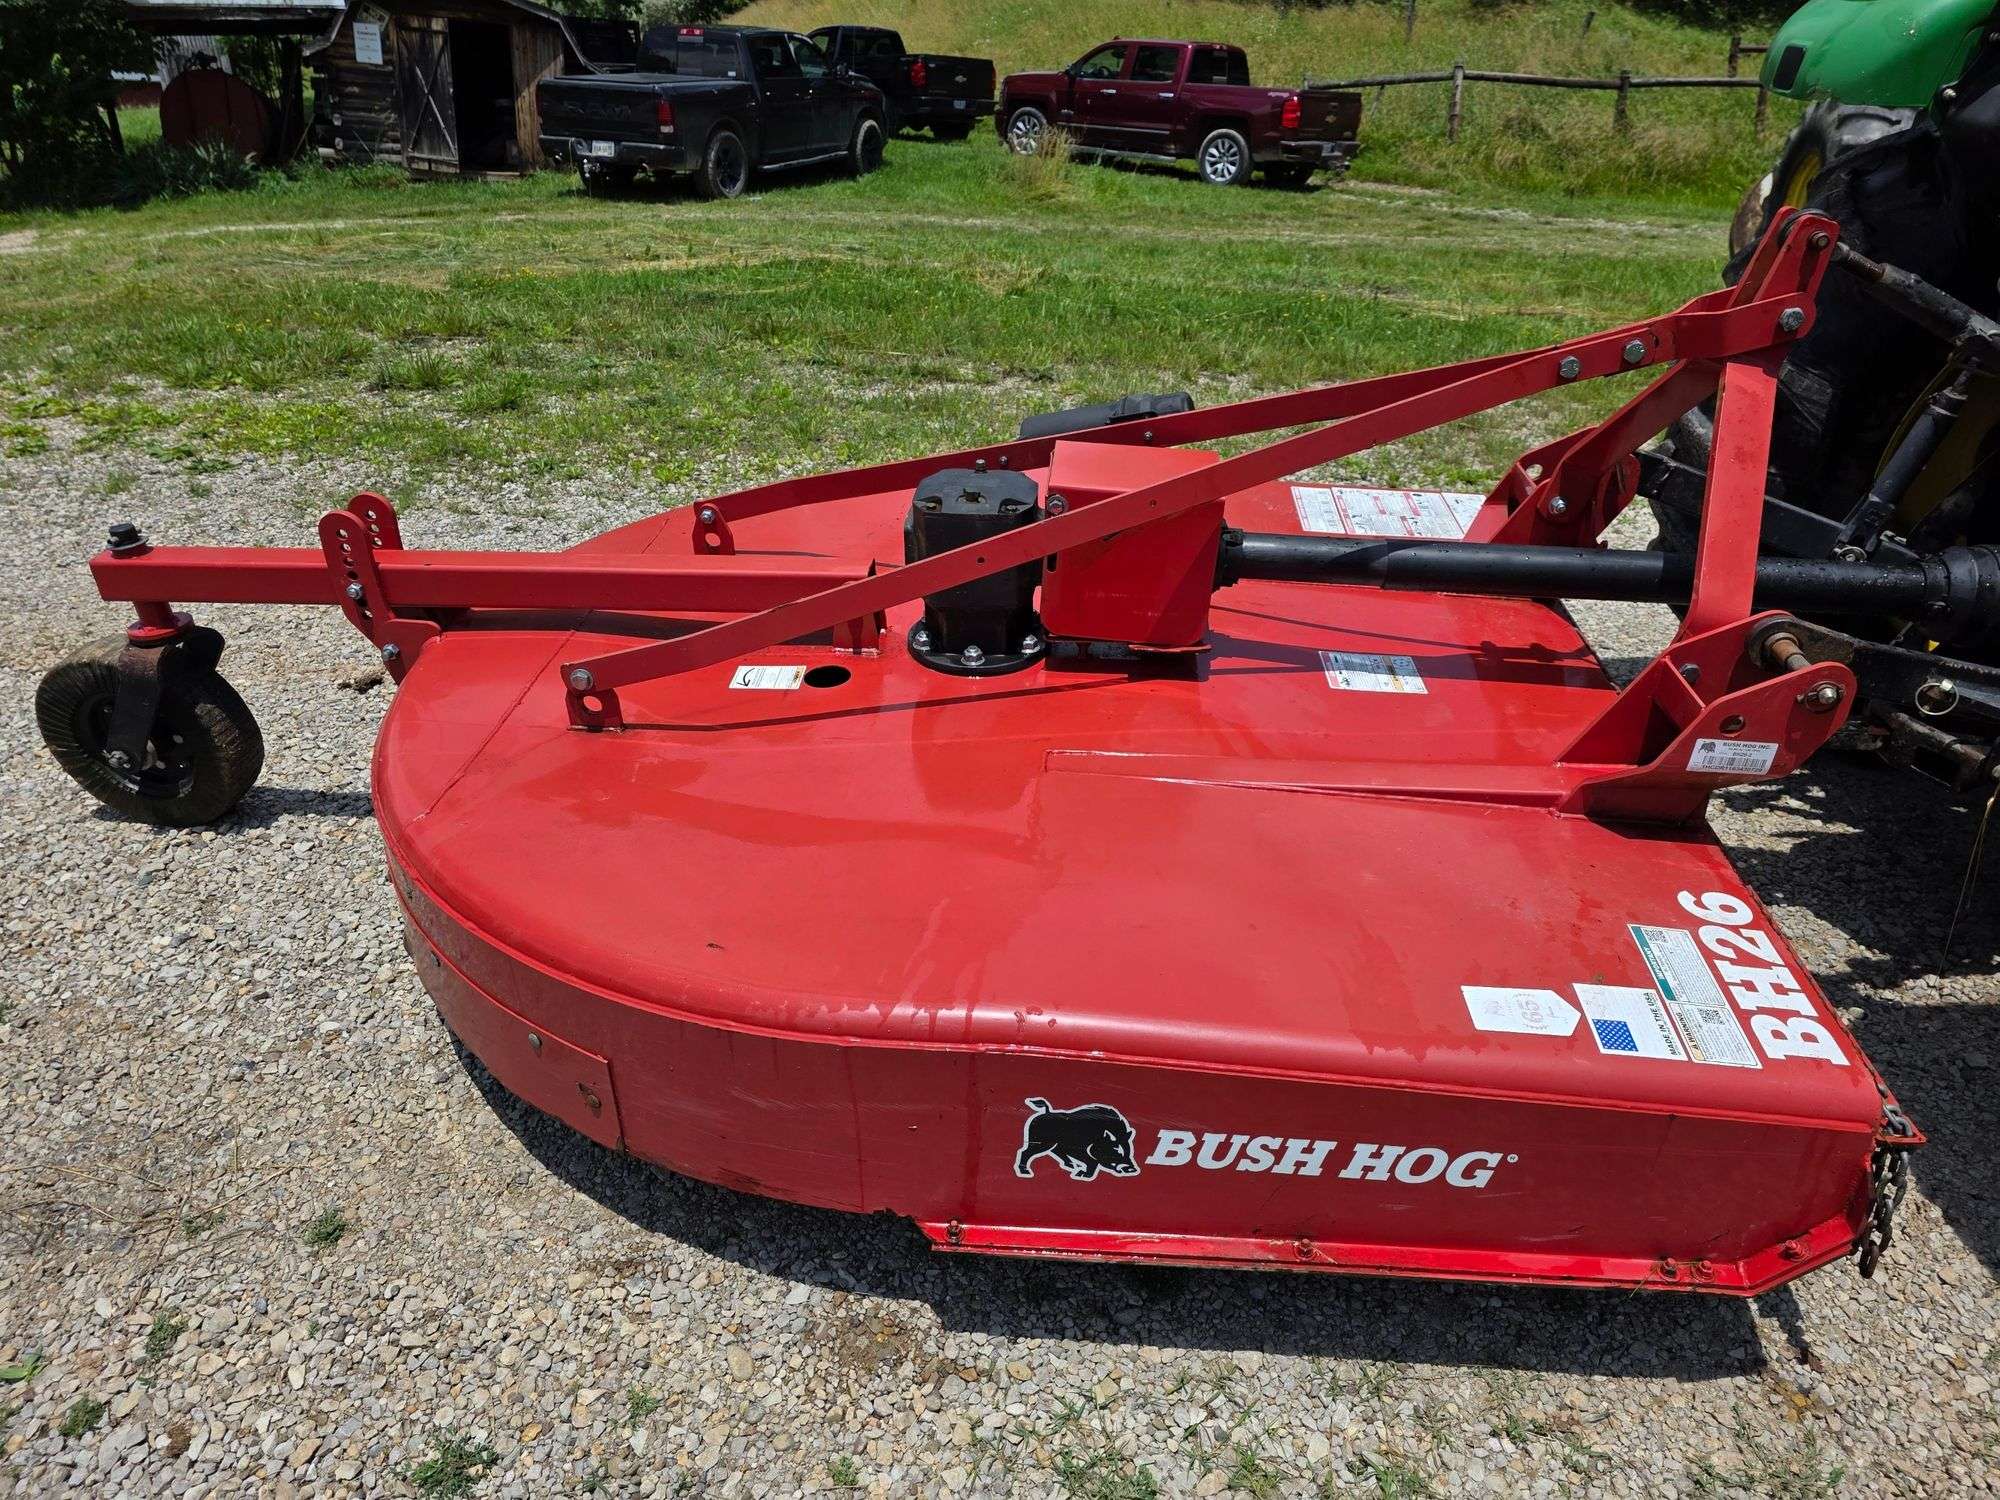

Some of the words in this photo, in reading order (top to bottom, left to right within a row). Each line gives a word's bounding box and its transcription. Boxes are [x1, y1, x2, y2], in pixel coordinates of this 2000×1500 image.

[1677, 890, 1851, 1066] BH26
[1643, 992, 1655, 1007] USA
[1650, 1007, 1661, 1022] THE
[1675, 1012, 1695, 1044] WARNING
[1662, 1034, 1678, 1056] MADE
[1145, 1129, 1338, 1176] BUSH
[1338, 1143, 1504, 1188] HOG
